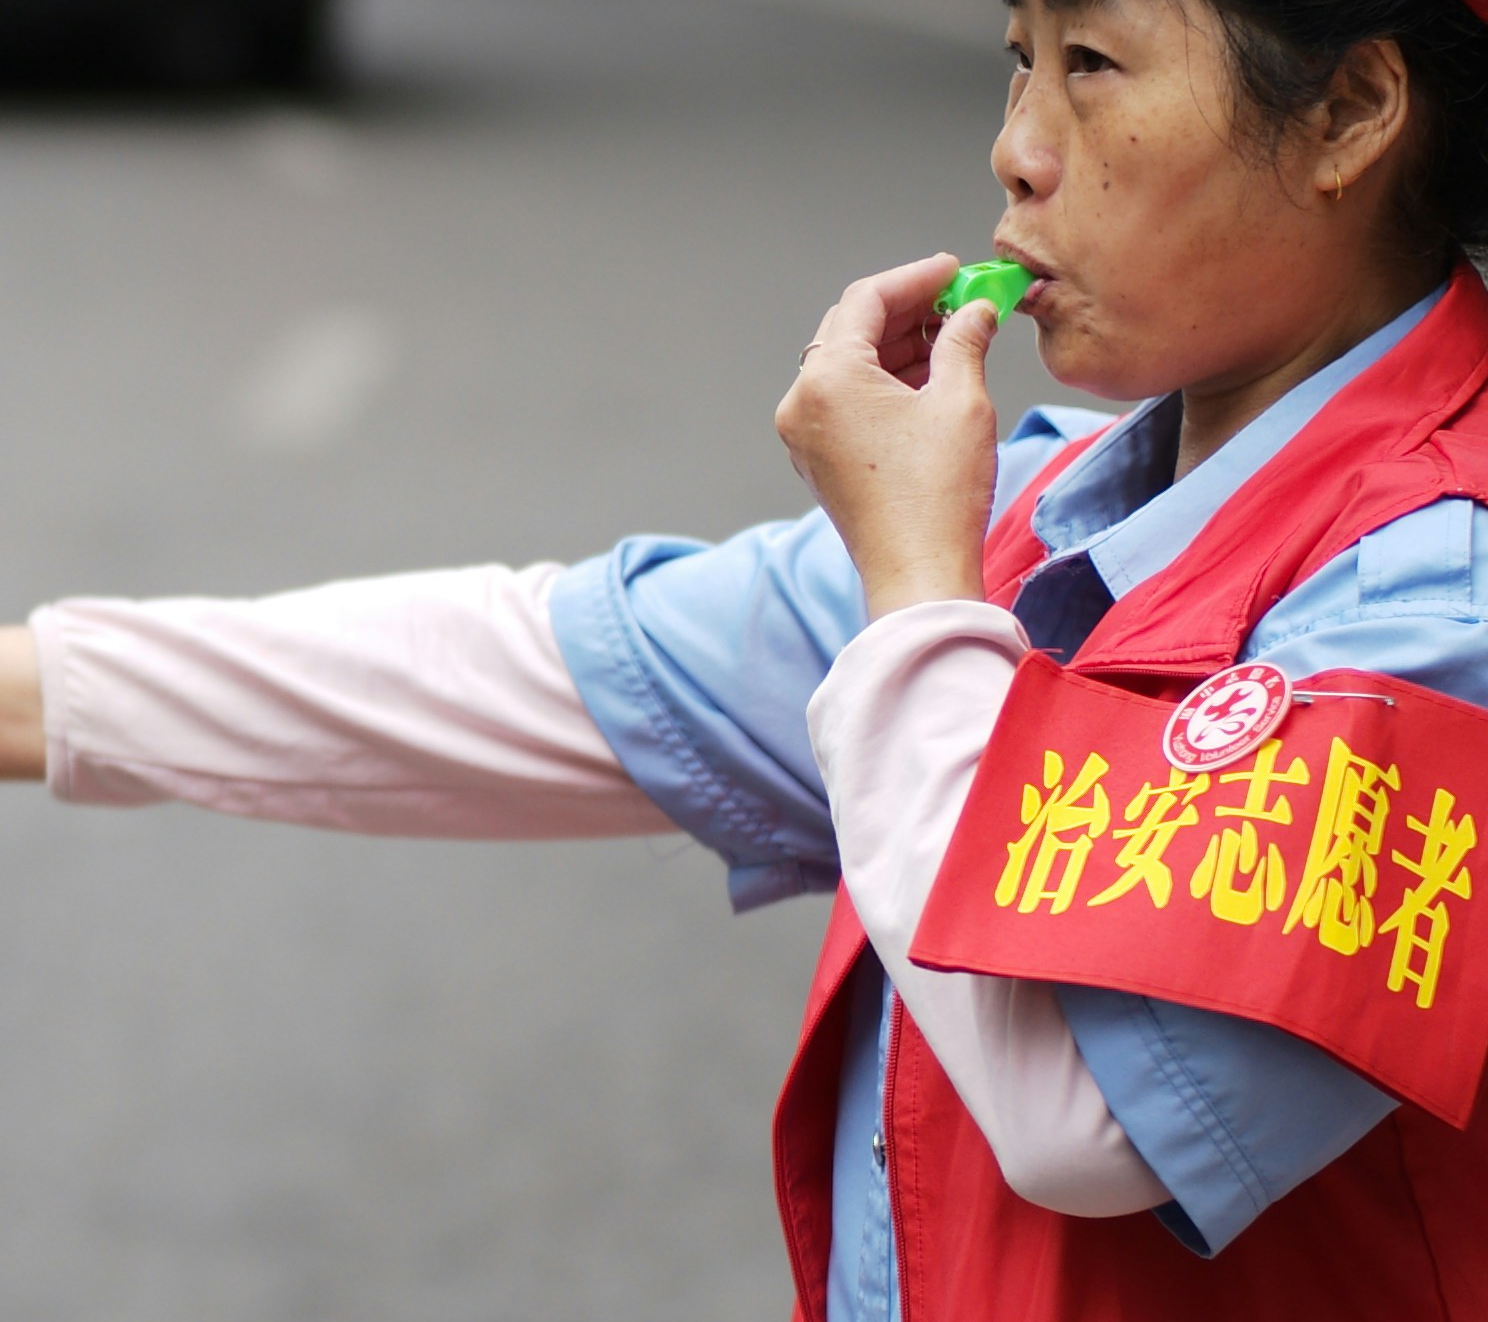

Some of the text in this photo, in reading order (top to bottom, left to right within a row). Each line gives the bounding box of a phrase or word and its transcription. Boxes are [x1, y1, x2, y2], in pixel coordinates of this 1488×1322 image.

[1253, 695, 1282, 733] Service
[994, 737, 1477, 1009] 治安志愿者
